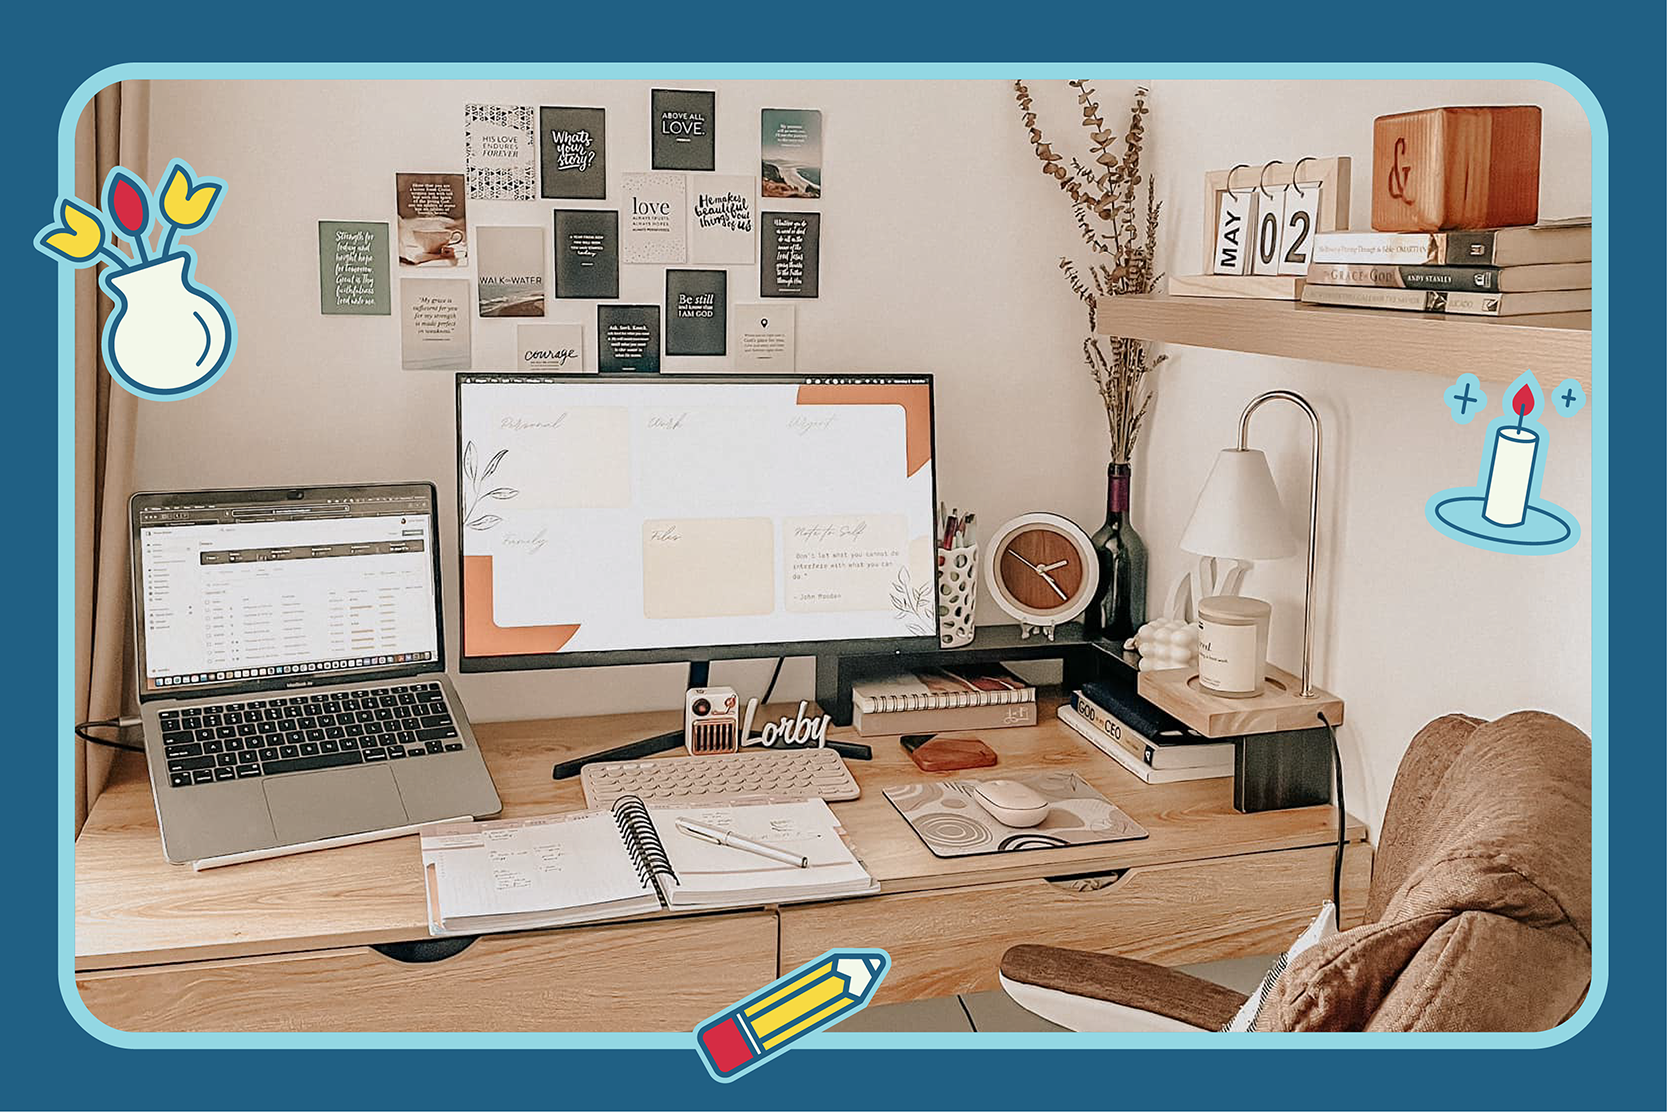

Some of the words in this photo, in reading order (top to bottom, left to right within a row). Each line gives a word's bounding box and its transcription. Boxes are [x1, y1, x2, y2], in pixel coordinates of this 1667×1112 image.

[662, 121, 705, 135] LOVE.
[557, 144, 587, 158] your
[557, 151, 596, 171] story?
[1388, 137, 1415, 206] &
[632, 196, 670, 215] love
[695, 198, 748, 218] beautiful
[700, 194, 714, 208] He
[715, 192, 741, 204] makes
[700, 212, 730, 228] things
[738, 220, 751, 232] us
[1220, 210, 1241, 268] MAY
[1330, 269, 1363, 281] GRACE
[1425, 275, 1452, 283] STANLEY
[679, 294, 693, 304] Be
[695, 294, 714, 304] still
[525, 349, 578, 366] courage
[840, 520, 867, 541] Self
[741, 698, 832, 748] Lorby
[1079, 701, 1095, 721] GOD
[1105, 720, 1121, 740] CEO
